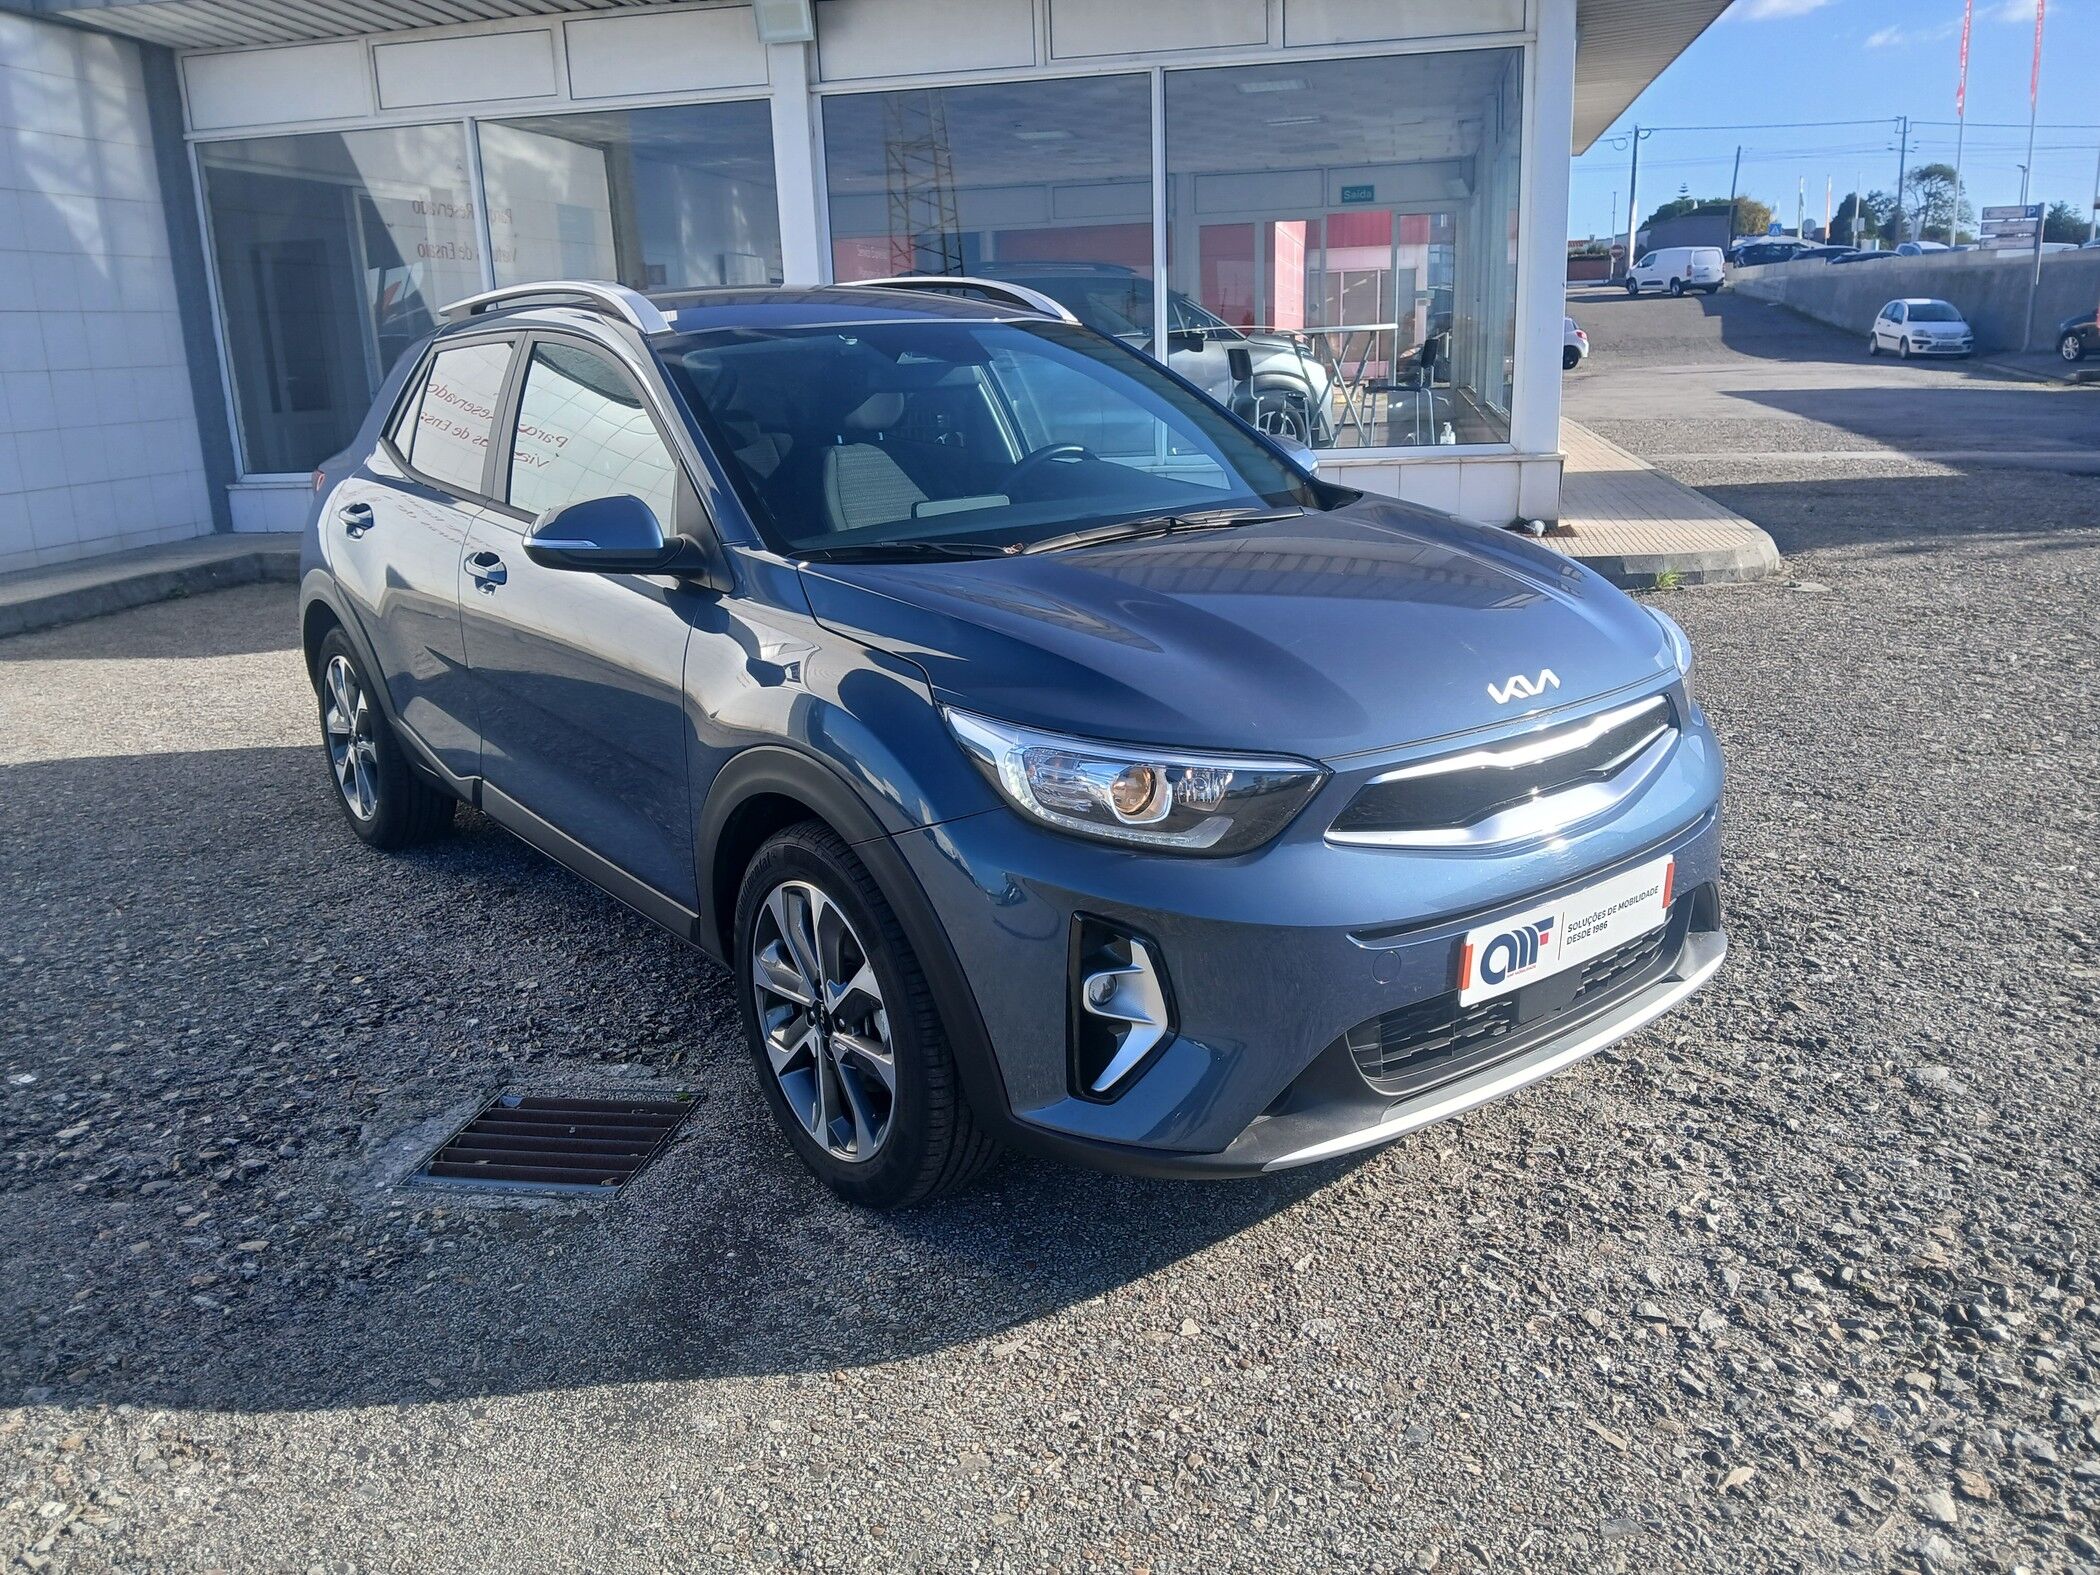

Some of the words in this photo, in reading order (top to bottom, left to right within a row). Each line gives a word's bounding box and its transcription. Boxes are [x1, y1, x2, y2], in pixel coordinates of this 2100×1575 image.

[2027, 207, 2036, 217] P
[1567, 911, 1606, 933] SOLUÇÕES
[1607, 904, 1617, 916] DE
[1618, 885, 1659, 911] MOBILIDADE
[1566, 927, 1591, 945] DESDE
[1592, 920, 1608, 934] 1986
